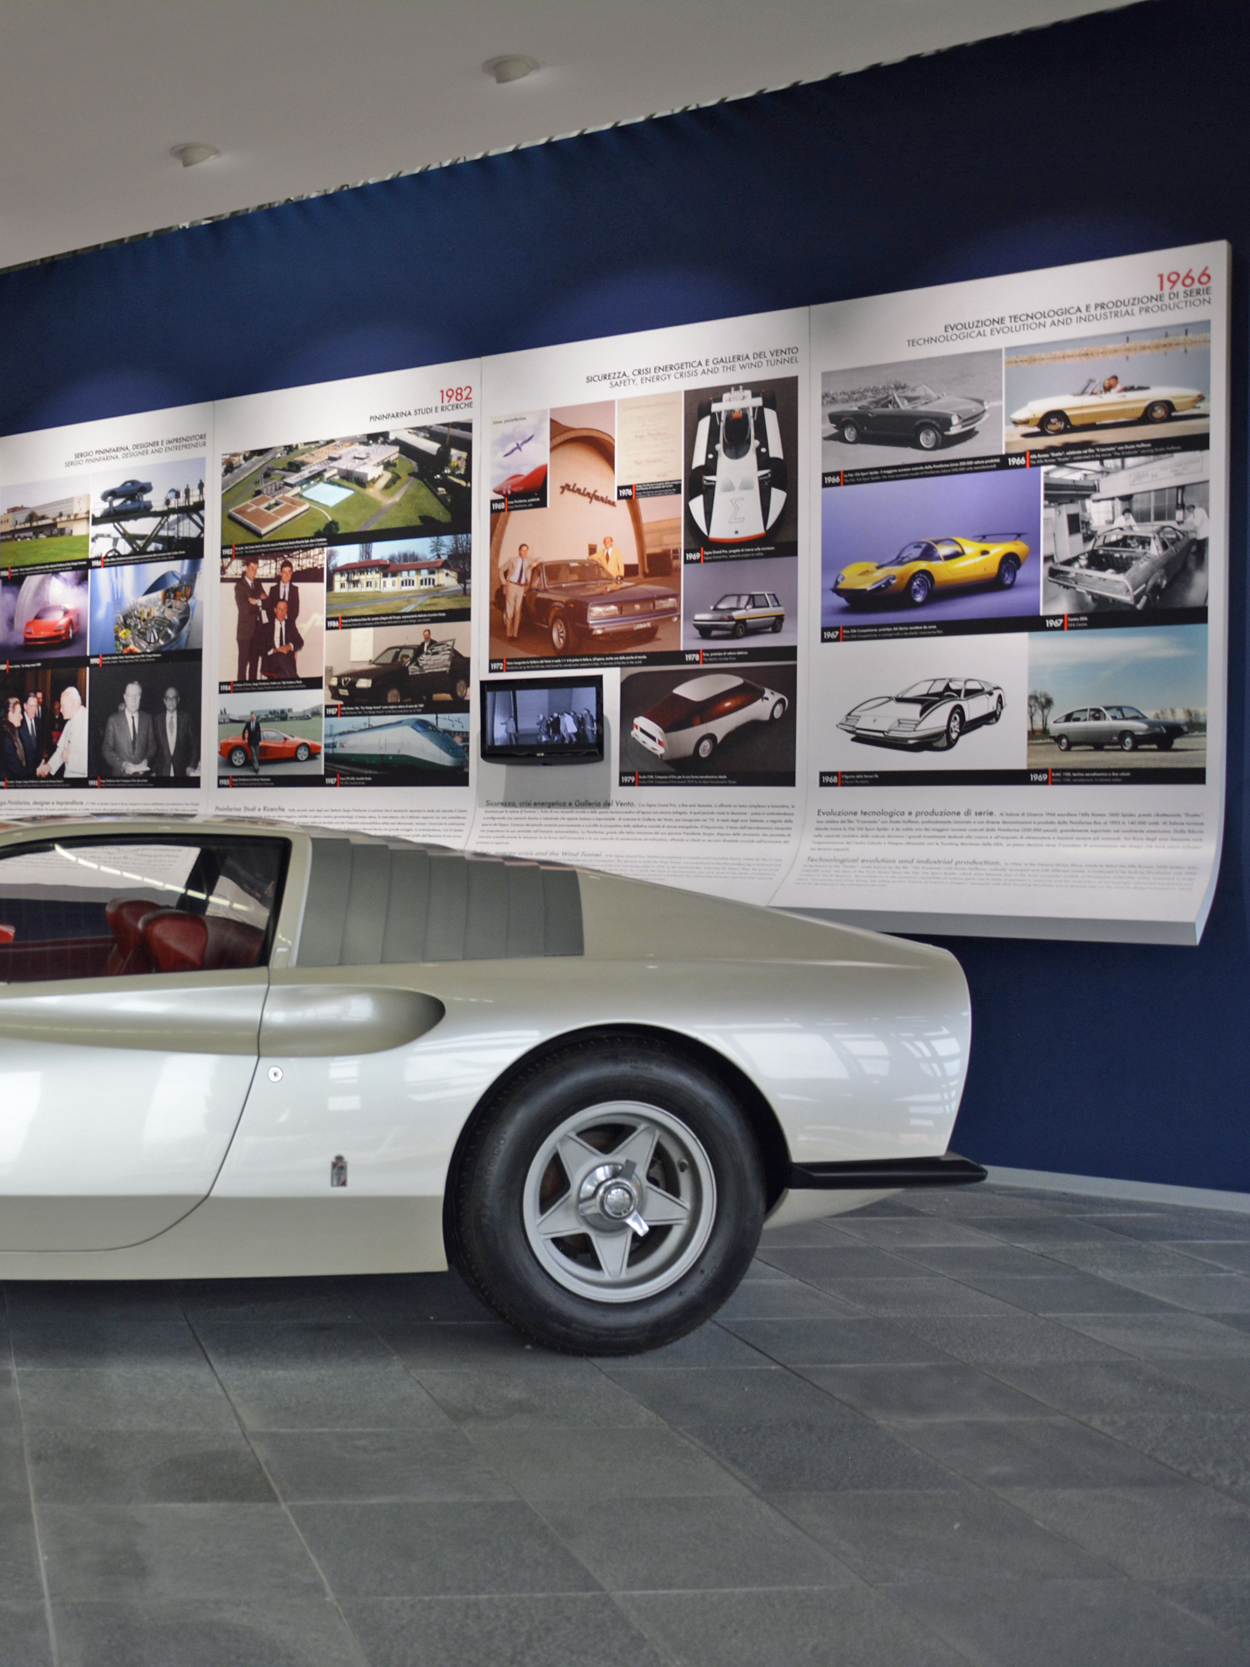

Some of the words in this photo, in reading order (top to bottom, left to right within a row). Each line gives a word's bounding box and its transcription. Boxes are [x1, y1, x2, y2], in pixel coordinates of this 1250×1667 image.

[1157, 266, 1212, 291] 1966
[944, 315, 1006, 333] EVOLUZIONE
[1009, 305, 1082, 324] TECNOLOGICA
[1085, 303, 1092, 313] E
[1094, 293, 1165, 312] PRODUZIONE
[1169, 291, 1180, 300] DI
[1183, 286, 1212, 299] SERIE
[906, 329, 987, 348] TECHNOLOGICAL
[990, 321, 1046, 337] EVOLUTION
[1050, 317, 1073, 329] AND
[1076, 307, 1136, 324] INDUSTRIAL
[1139, 297, 1212, 315] PRODUCTION
[586, 371, 629, 384] SICUREZZA,
[632, 367, 651, 377] CRISI
[654, 360, 703, 374] ENERGETICA
[713, 354, 750, 366] GALLERIA
[753, 351, 767, 360] DEL
[770, 346, 799, 358] VENTO
[609, 377, 638, 388] SAFETY,
[640, 373, 671, 385] ENERGY
[674, 369, 698, 380] CRISIS
[701, 366, 720, 376] AND
[722, 364, 737, 373] THE
[739, 360, 763, 371] WIND
[766, 356, 799, 368] TUNNEL
[440, 385, 472, 404] 1982
[369, 410, 412, 422] PININFARINA
[414, 407, 433, 416] STUDI
[440, 401, 473, 412] RICERCHE
[74, 451, 94, 459] SERGIO
[132, 440, 160, 450] DESIGNER
[166, 433, 207, 445] IMPRENDITORE
[64, 459, 84, 467] SERGIO
[122, 449, 149, 459] DESIGNER
[165, 441, 207, 452] ENTREPRENEUR
[1008, 457, 1026, 466] 1966
[824, 476, 841, 485] 1966
[559, 483, 617, 508] pininfarina
[618, 488, 632, 497] 1976
[685, 552, 701, 561] 1969
[1046, 618, 1064, 628] 1967
[823, 631, 840, 639] 1967
[490, 662, 504, 670] 1972
[822, 775, 838, 784] 1968
[1030, 773, 1048, 782] 1969
[486, 800, 517, 808] Sicurezza,
[533, 800, 566, 809] energetica
[817, 809, 858, 817] Evoluzione
[860, 809, 905, 818] tecnologica
[915, 809, 961, 819] produzione
[964, 809, 972, 817] di
[806, 856, 859, 866] Technological
[916, 857, 953, 865] industrial
